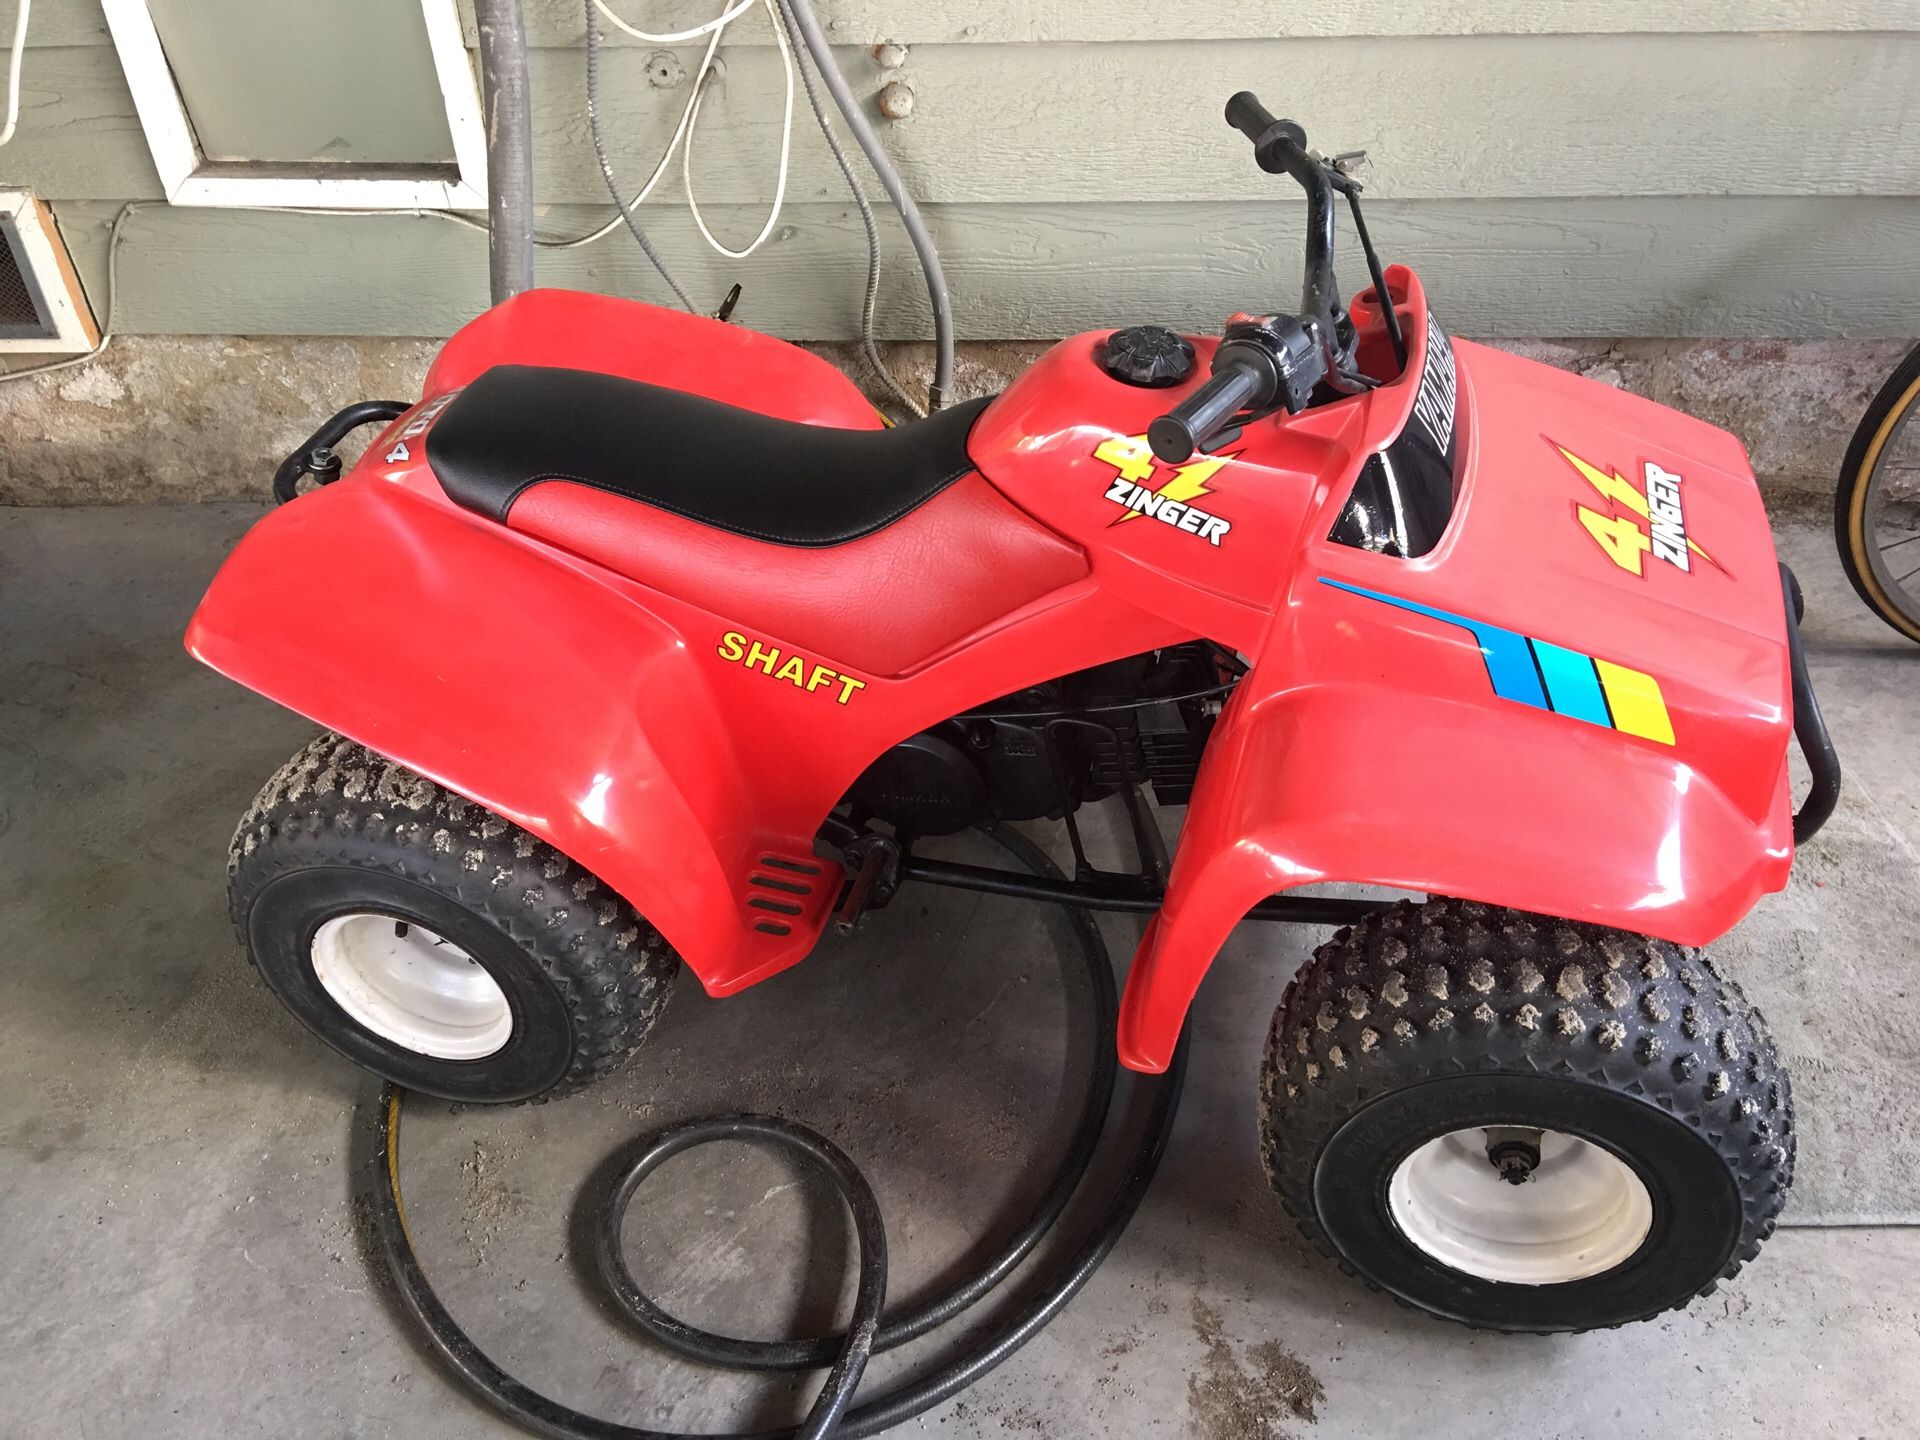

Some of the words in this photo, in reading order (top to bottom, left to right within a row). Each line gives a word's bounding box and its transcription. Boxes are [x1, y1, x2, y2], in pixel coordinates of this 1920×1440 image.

[1414, 310, 1456, 457] YAMAHA
[1092, 432, 1157, 483] 4
[1104, 477, 1232, 547] ZINGER
[1575, 502, 1652, 579] 4
[1644, 461, 1691, 573] ZINGER
[717, 630, 867, 705] SHAFT
